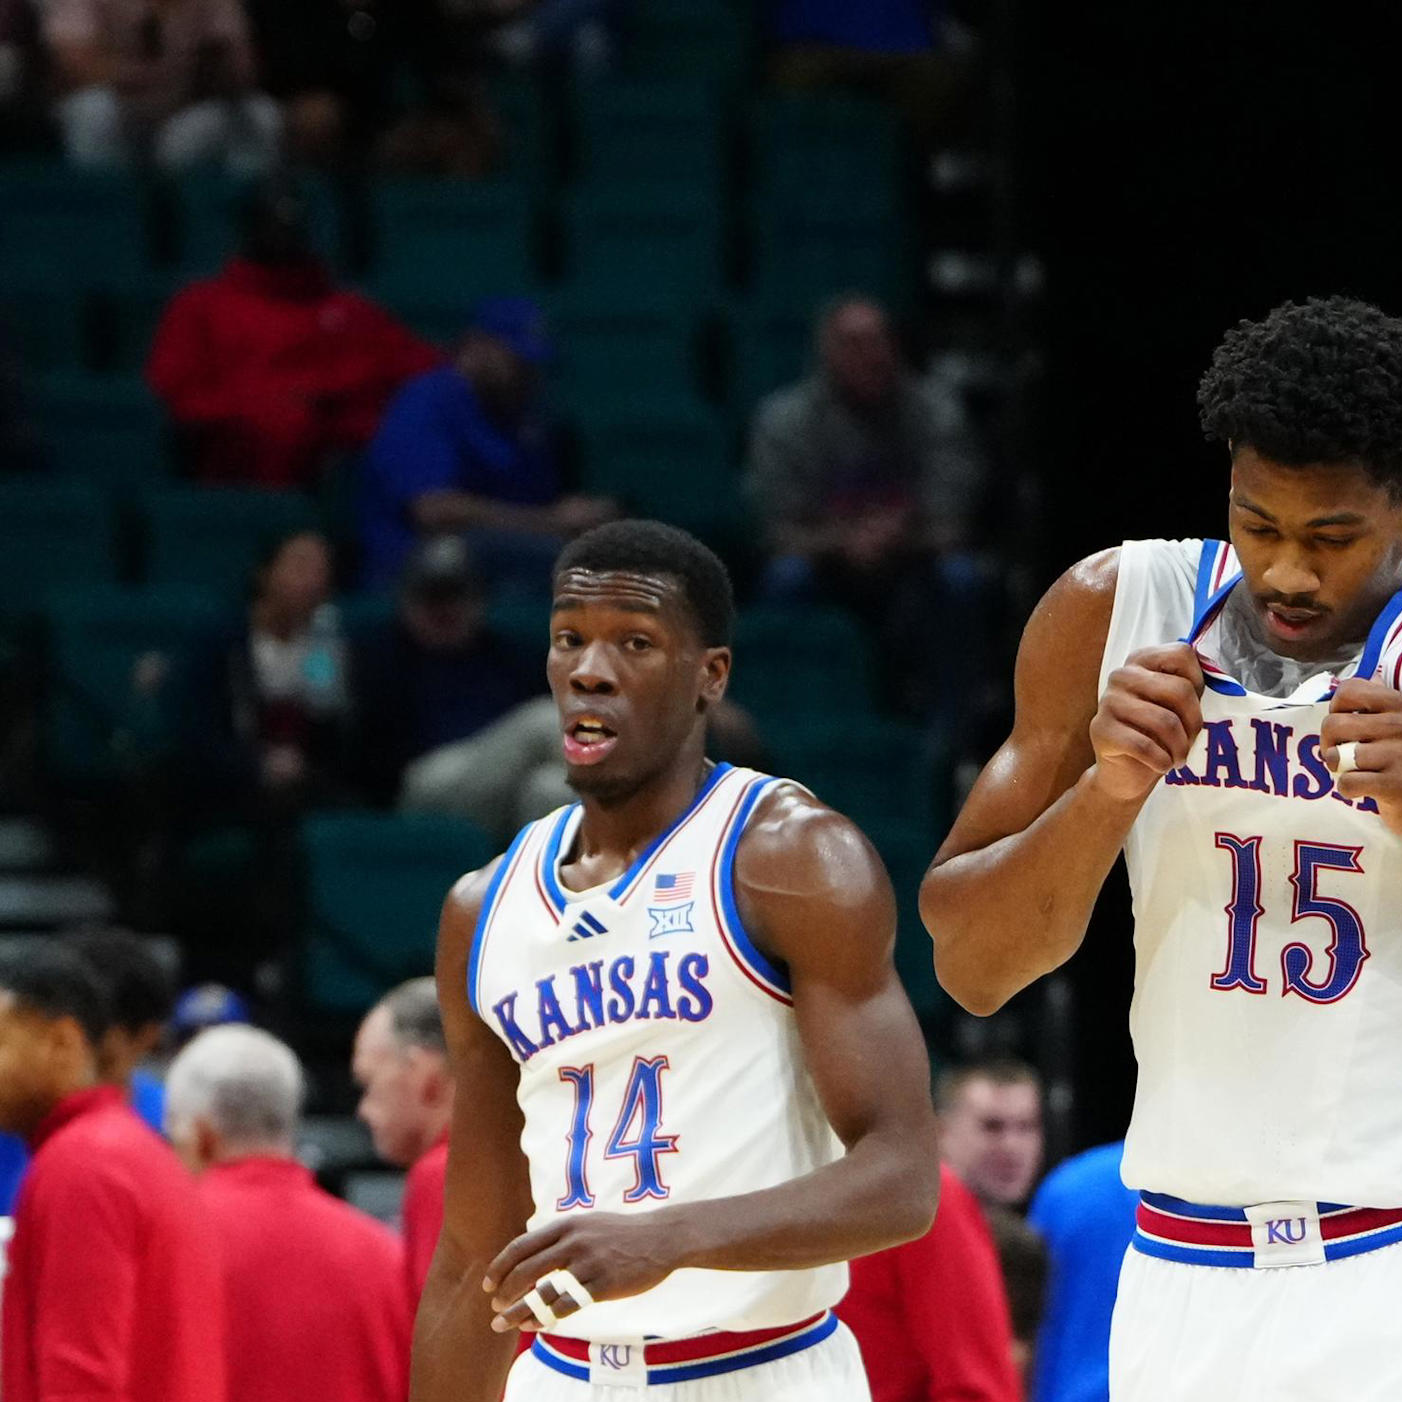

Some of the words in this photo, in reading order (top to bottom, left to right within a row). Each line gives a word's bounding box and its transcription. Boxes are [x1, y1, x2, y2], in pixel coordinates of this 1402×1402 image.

[1165, 718, 1380, 815] ANS
[1210, 832, 1371, 1005] 15
[492, 950, 714, 1062] KANSAS
[556, 1055, 681, 1212] 14
[1265, 1217, 1307, 1245] KU
[600, 1344, 632, 1370] KU
